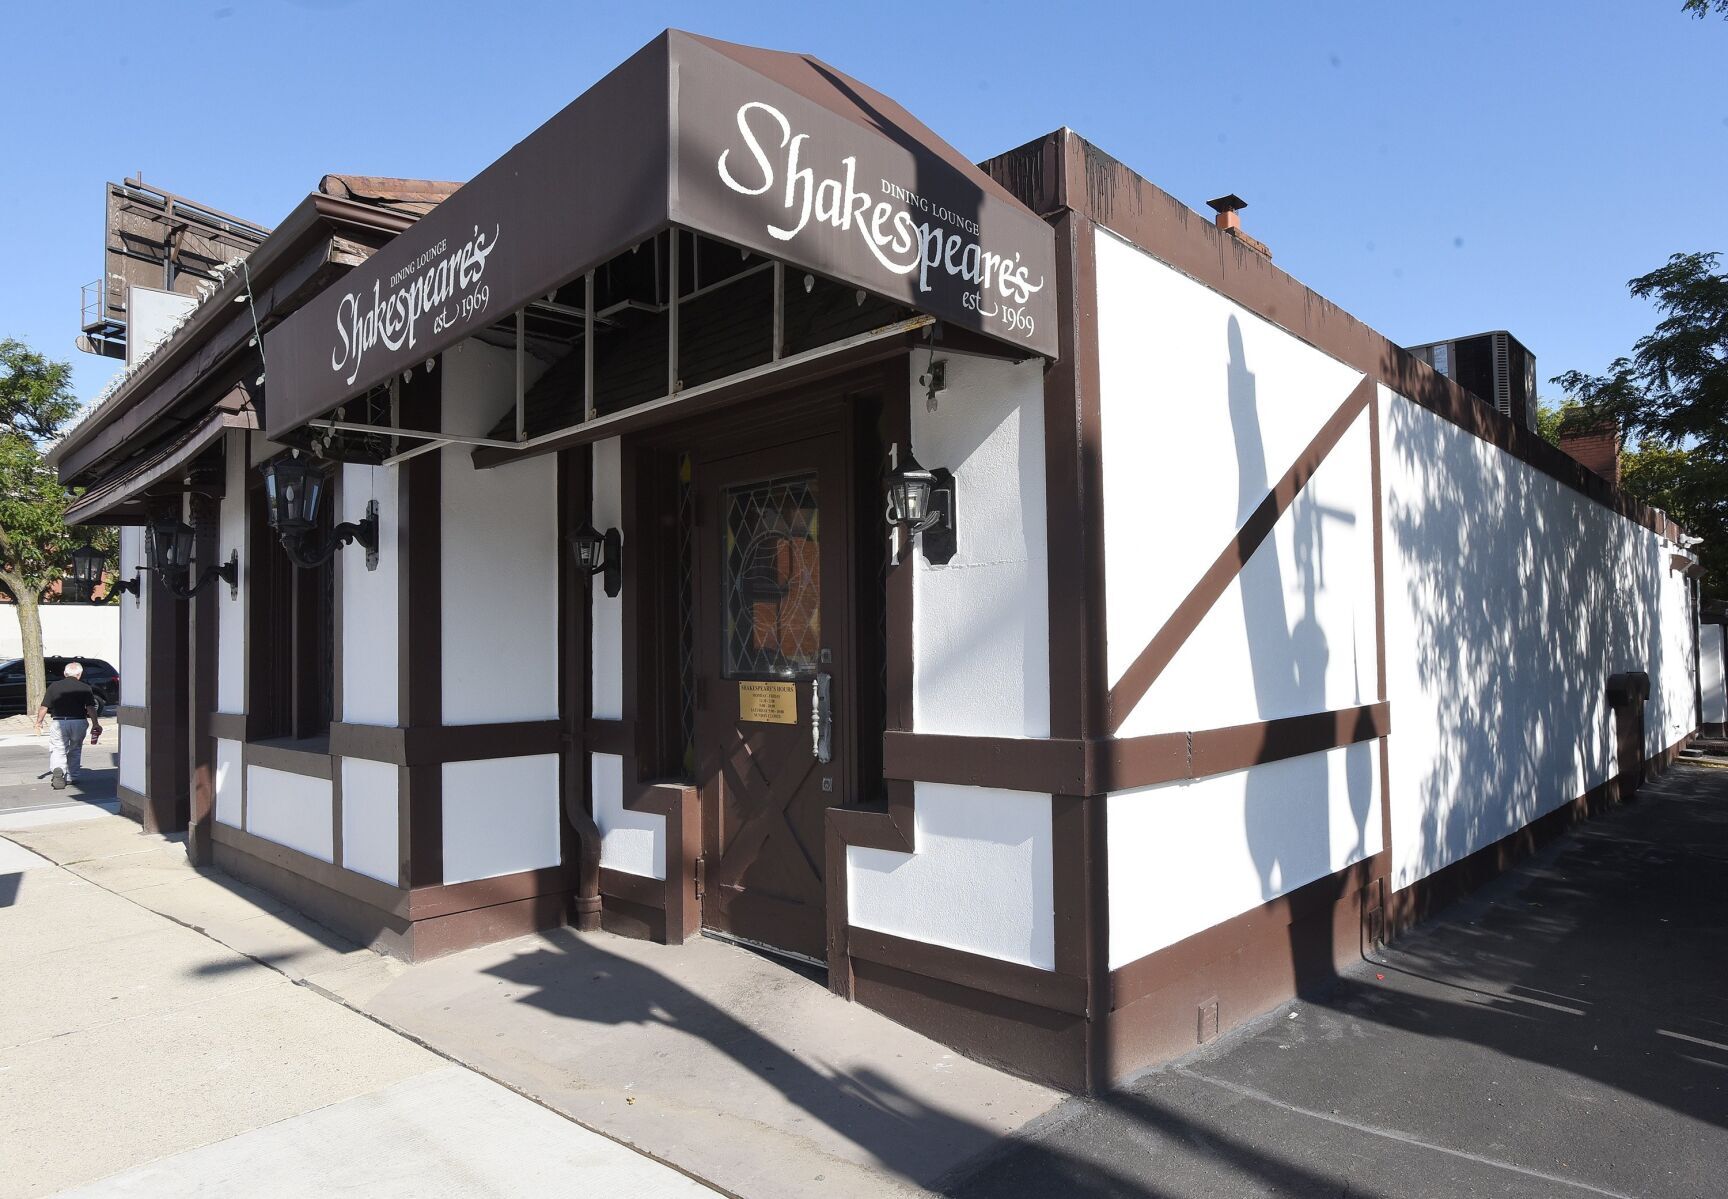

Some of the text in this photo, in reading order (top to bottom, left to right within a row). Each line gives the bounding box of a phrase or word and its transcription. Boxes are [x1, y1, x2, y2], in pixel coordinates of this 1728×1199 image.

[718, 101, 1044, 304] Shakespeare's
[881, 178, 980, 236] DINING LOUNGE
[390, 238, 447, 288] DINING LOUNGE
[332, 224, 499, 386] Shakespeare's
[434, 281, 489, 334] est 1969
[962, 289, 1035, 338] est 1969
